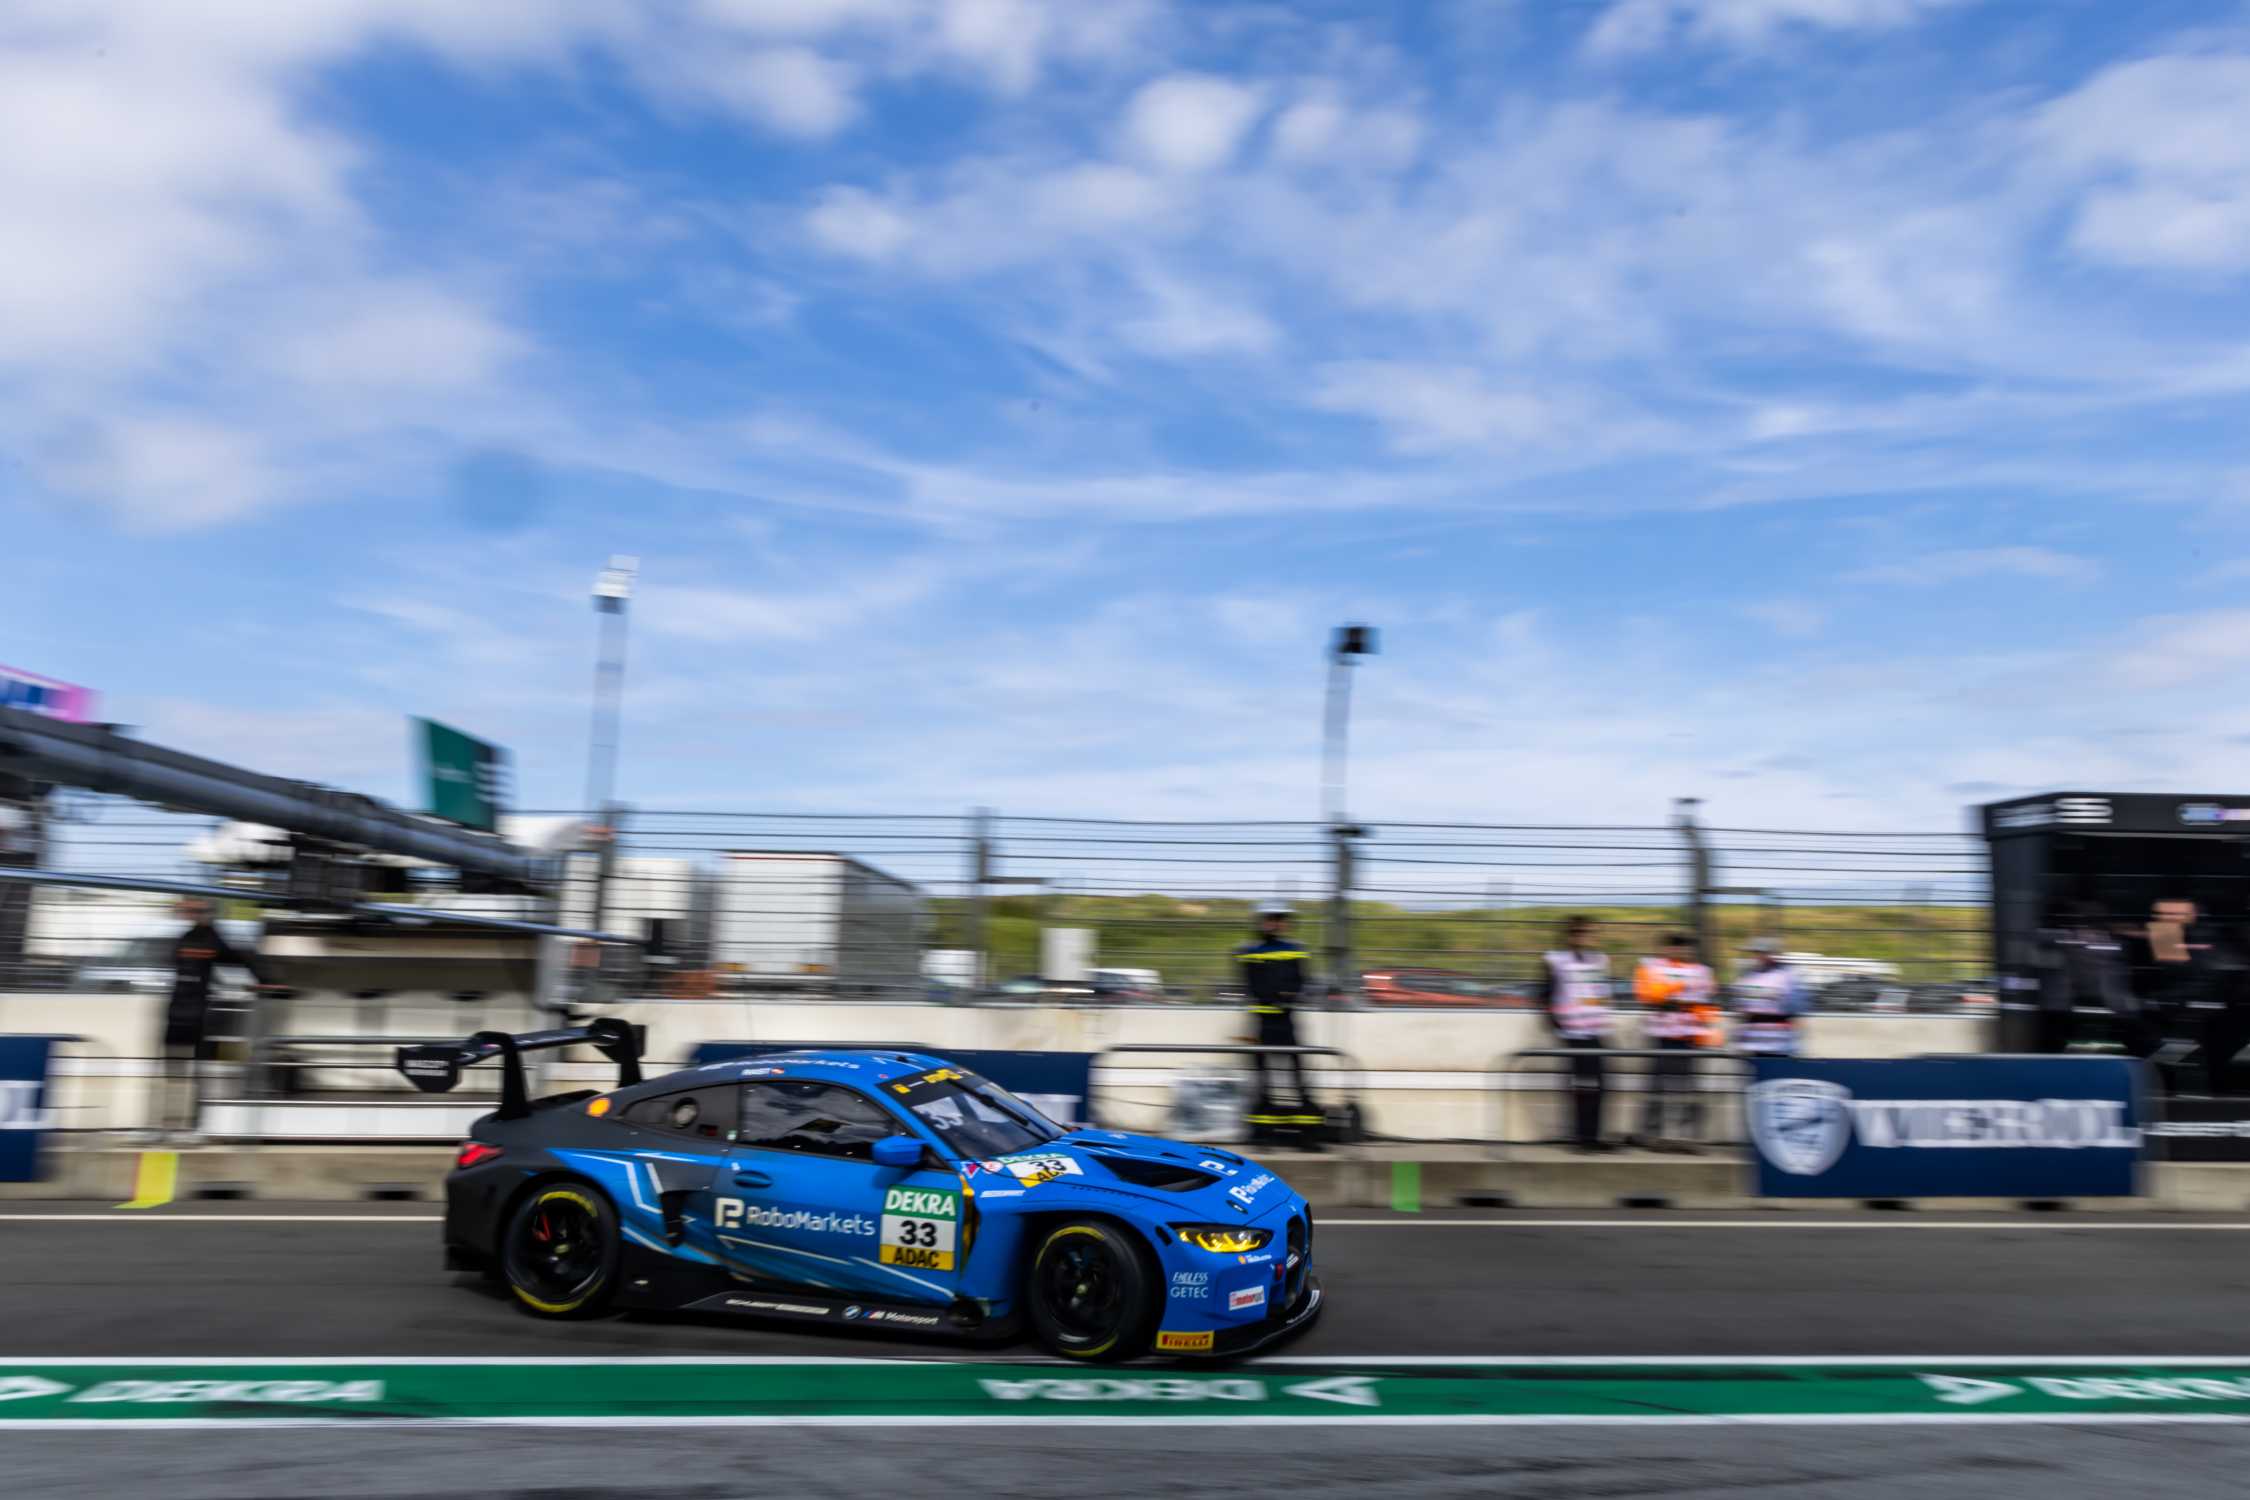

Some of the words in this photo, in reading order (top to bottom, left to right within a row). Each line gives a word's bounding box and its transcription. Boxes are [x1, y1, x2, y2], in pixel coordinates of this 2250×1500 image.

[1029, 1159, 1067, 1172] 33
[885, 1189, 956, 1216] DEKRA
[747, 1206, 876, 1236] RoboMarkets
[899, 1220, 937, 1247] 33
[893, 1247, 940, 1269] ADAC
[1170, 1287, 1208, 1298] GETEC
[885, 1312, 939, 1325] Motorsport
